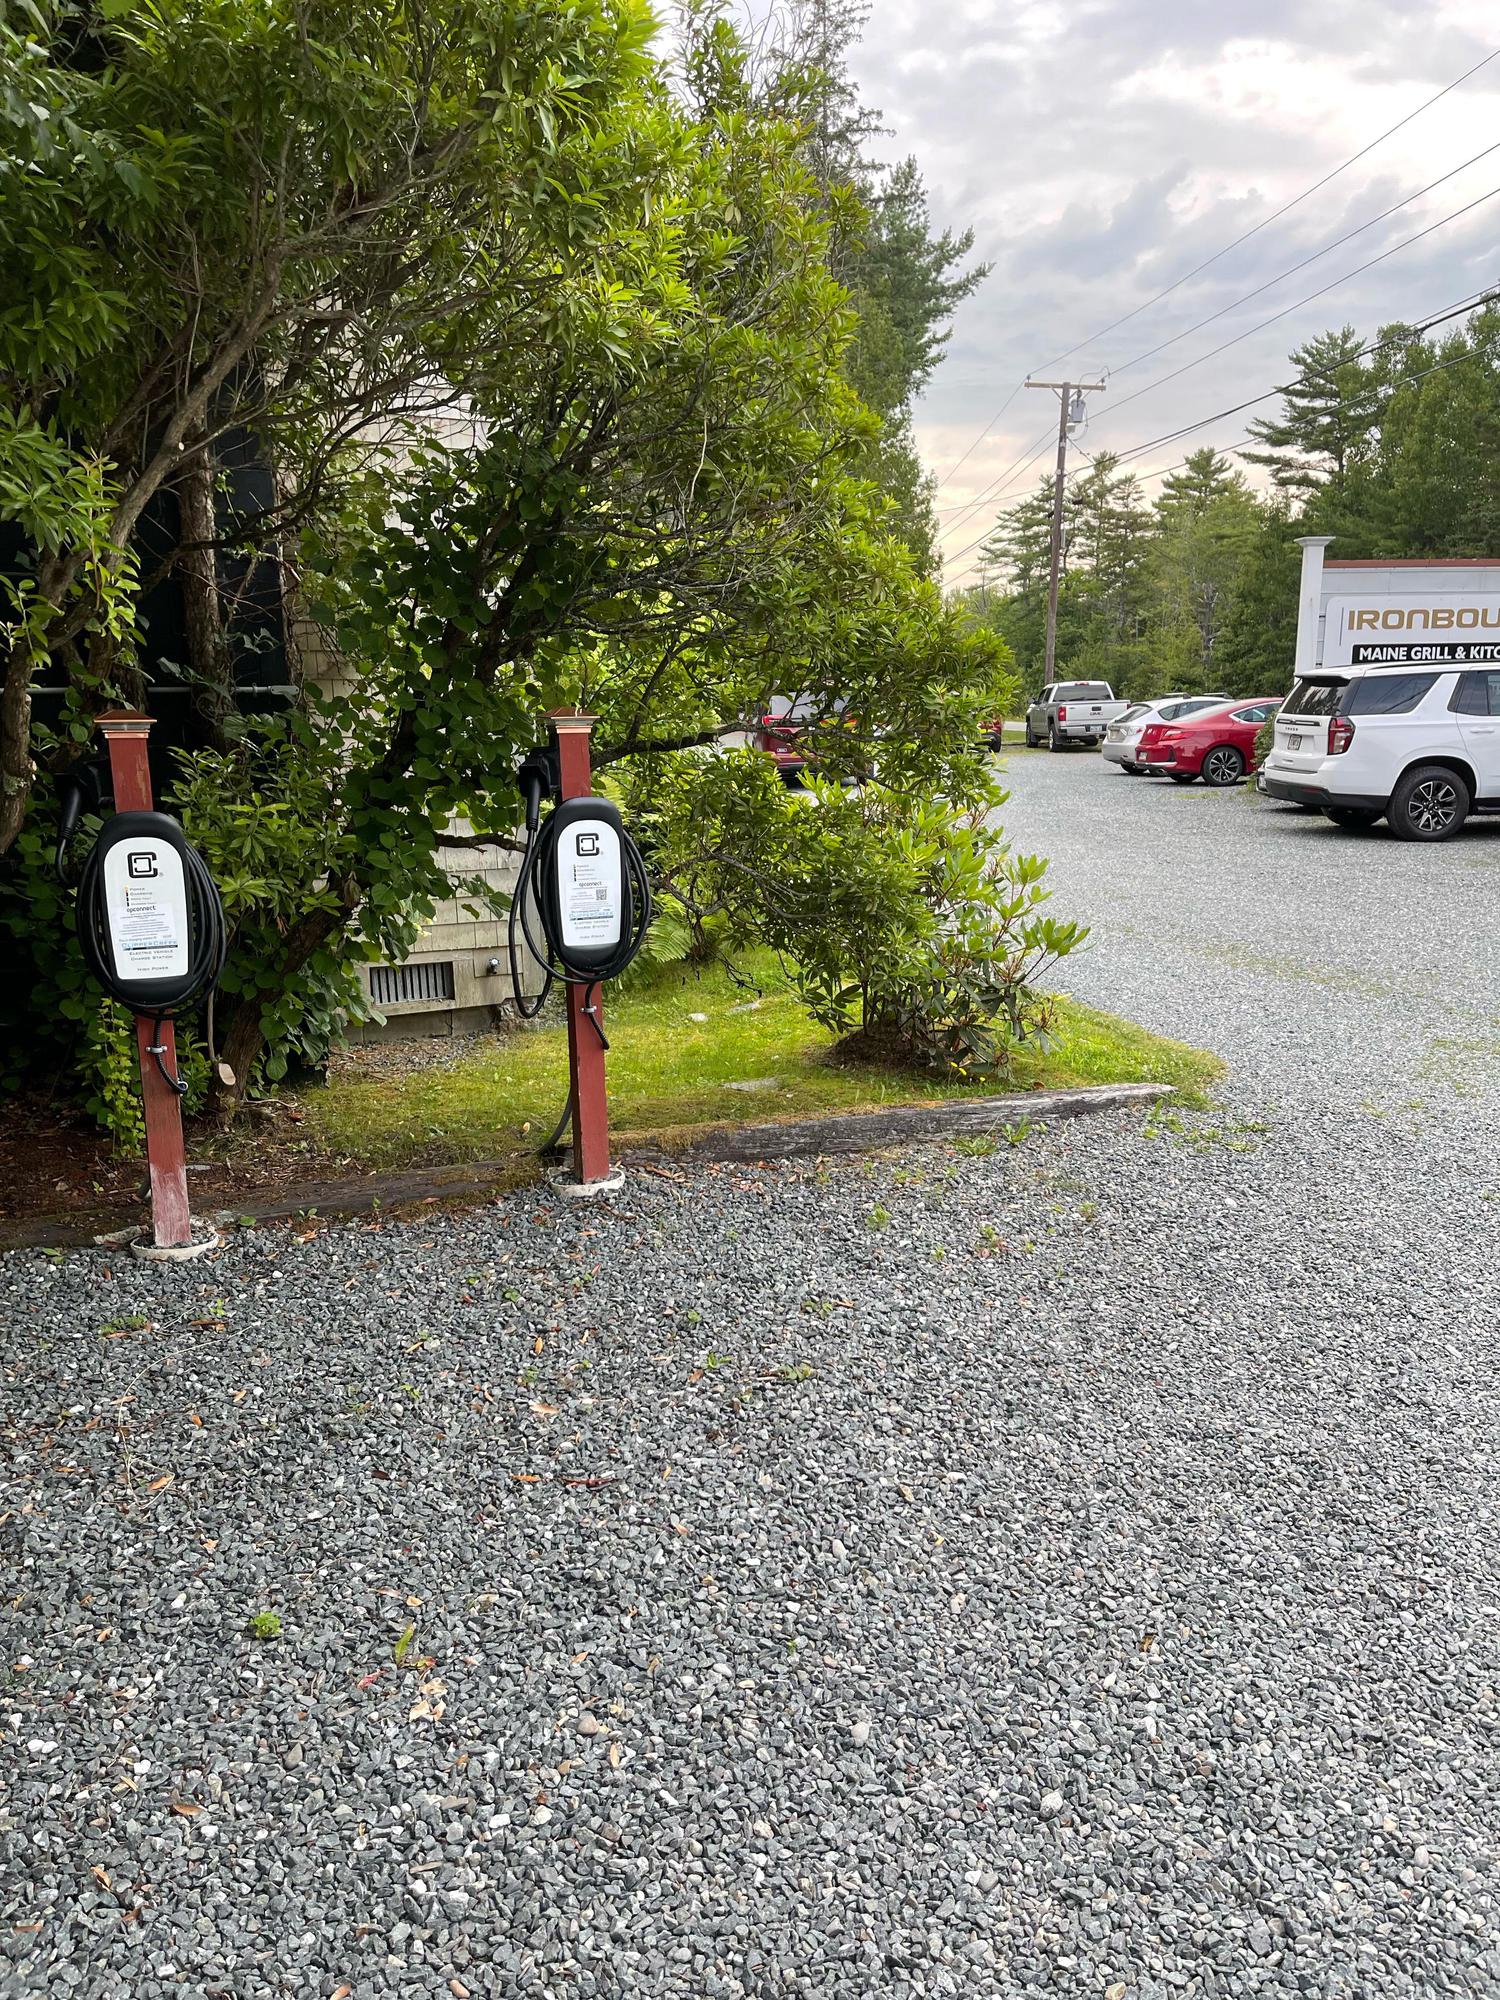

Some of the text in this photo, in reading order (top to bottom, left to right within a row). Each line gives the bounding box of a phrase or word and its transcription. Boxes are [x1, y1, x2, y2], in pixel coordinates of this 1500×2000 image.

[1348, 608, 1500, 630] IRONBOU
[1359, 647, 1407, 661] MAINE
[1411, 646, 1452, 660] GRILL
[1455, 645, 1466, 660] &
